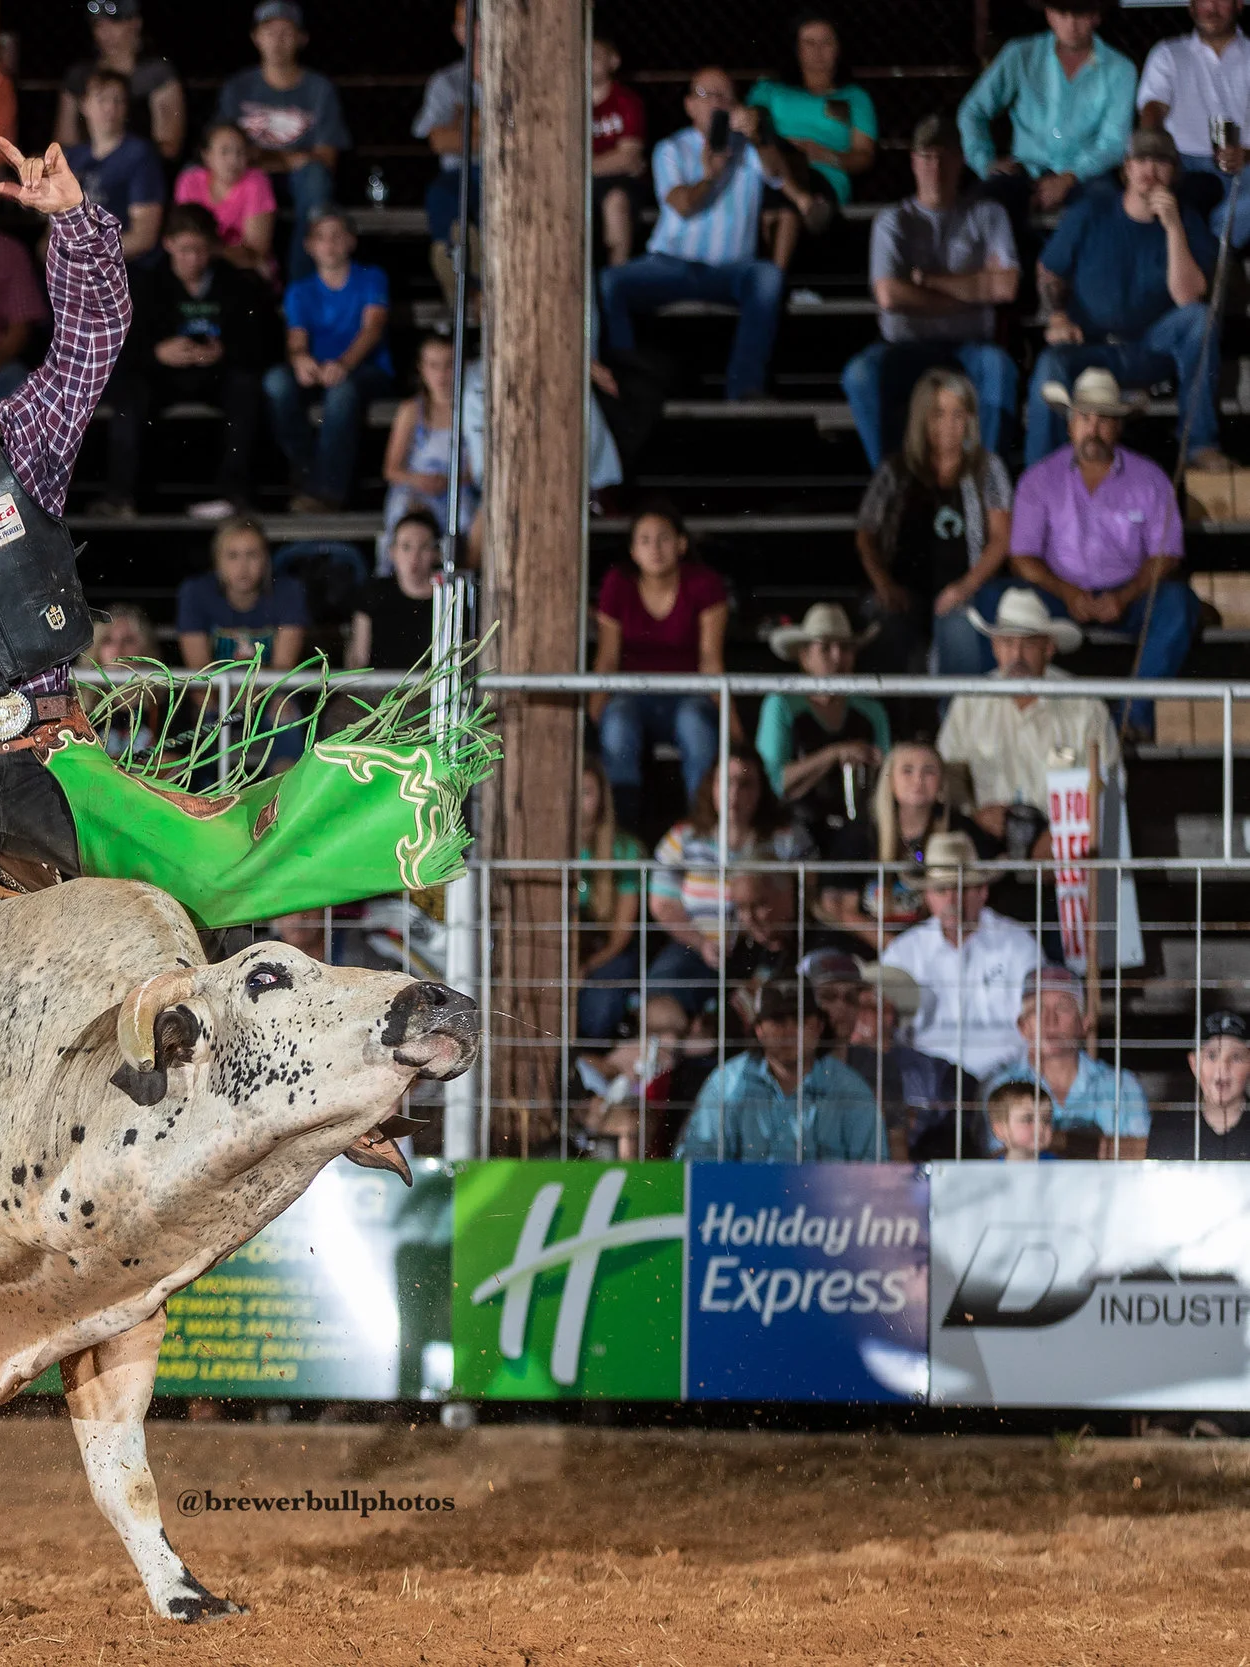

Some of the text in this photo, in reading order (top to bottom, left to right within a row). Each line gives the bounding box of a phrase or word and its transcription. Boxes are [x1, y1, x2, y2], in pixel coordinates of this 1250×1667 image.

[699, 1202, 919, 1256] Holiday Inn
[699, 1255, 909, 1327] Express
